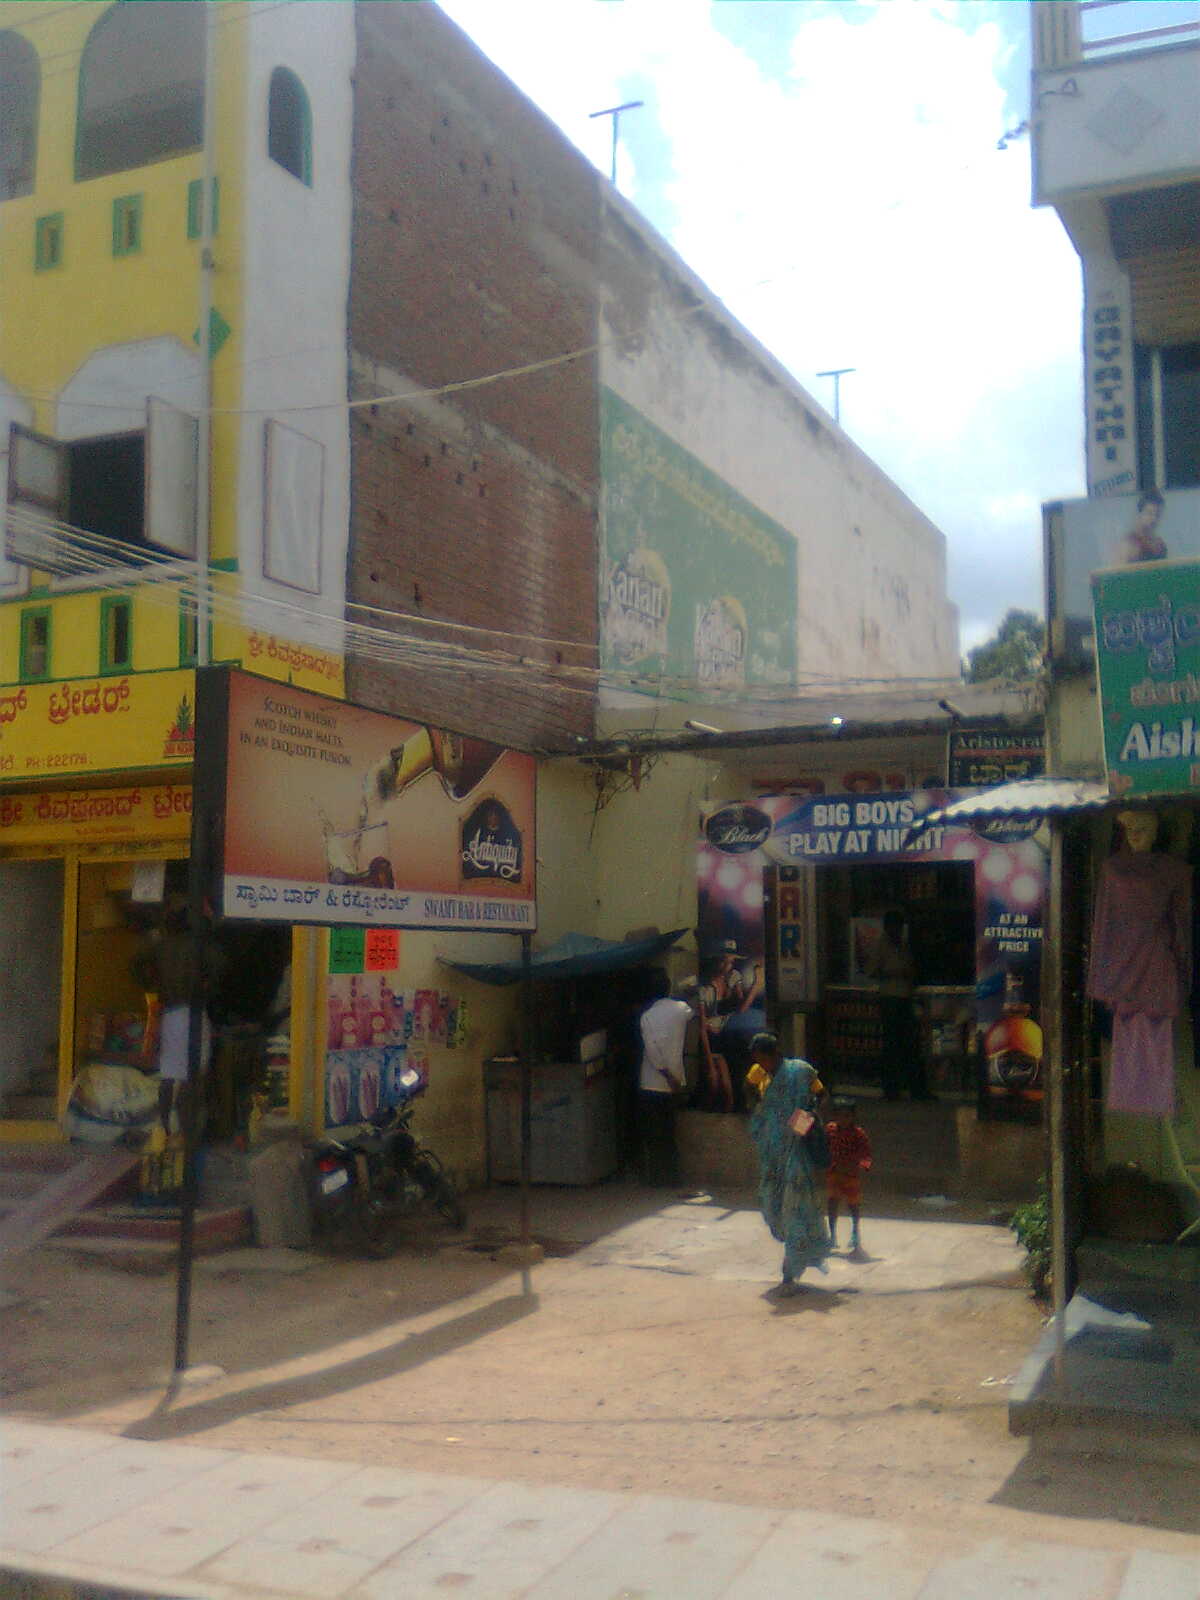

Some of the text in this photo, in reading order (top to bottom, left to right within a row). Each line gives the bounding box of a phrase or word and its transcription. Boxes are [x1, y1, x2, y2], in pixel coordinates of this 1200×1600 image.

[240, 731, 251, 744] IN
[254, 718, 277, 730] AND
[279, 720, 314, 738] INDIAN
[813, 799, 915, 827] BIG BOYS
[789, 830, 842, 855] PLAY
[844, 829, 872, 854] AT
[462, 827, 520, 879] Antiquity
[326, 888, 338, 907] &
[458, 900, 475, 920] BAR
[999, 912, 1029, 924] AT AN
[998, 940, 1030, 953] PRICE
